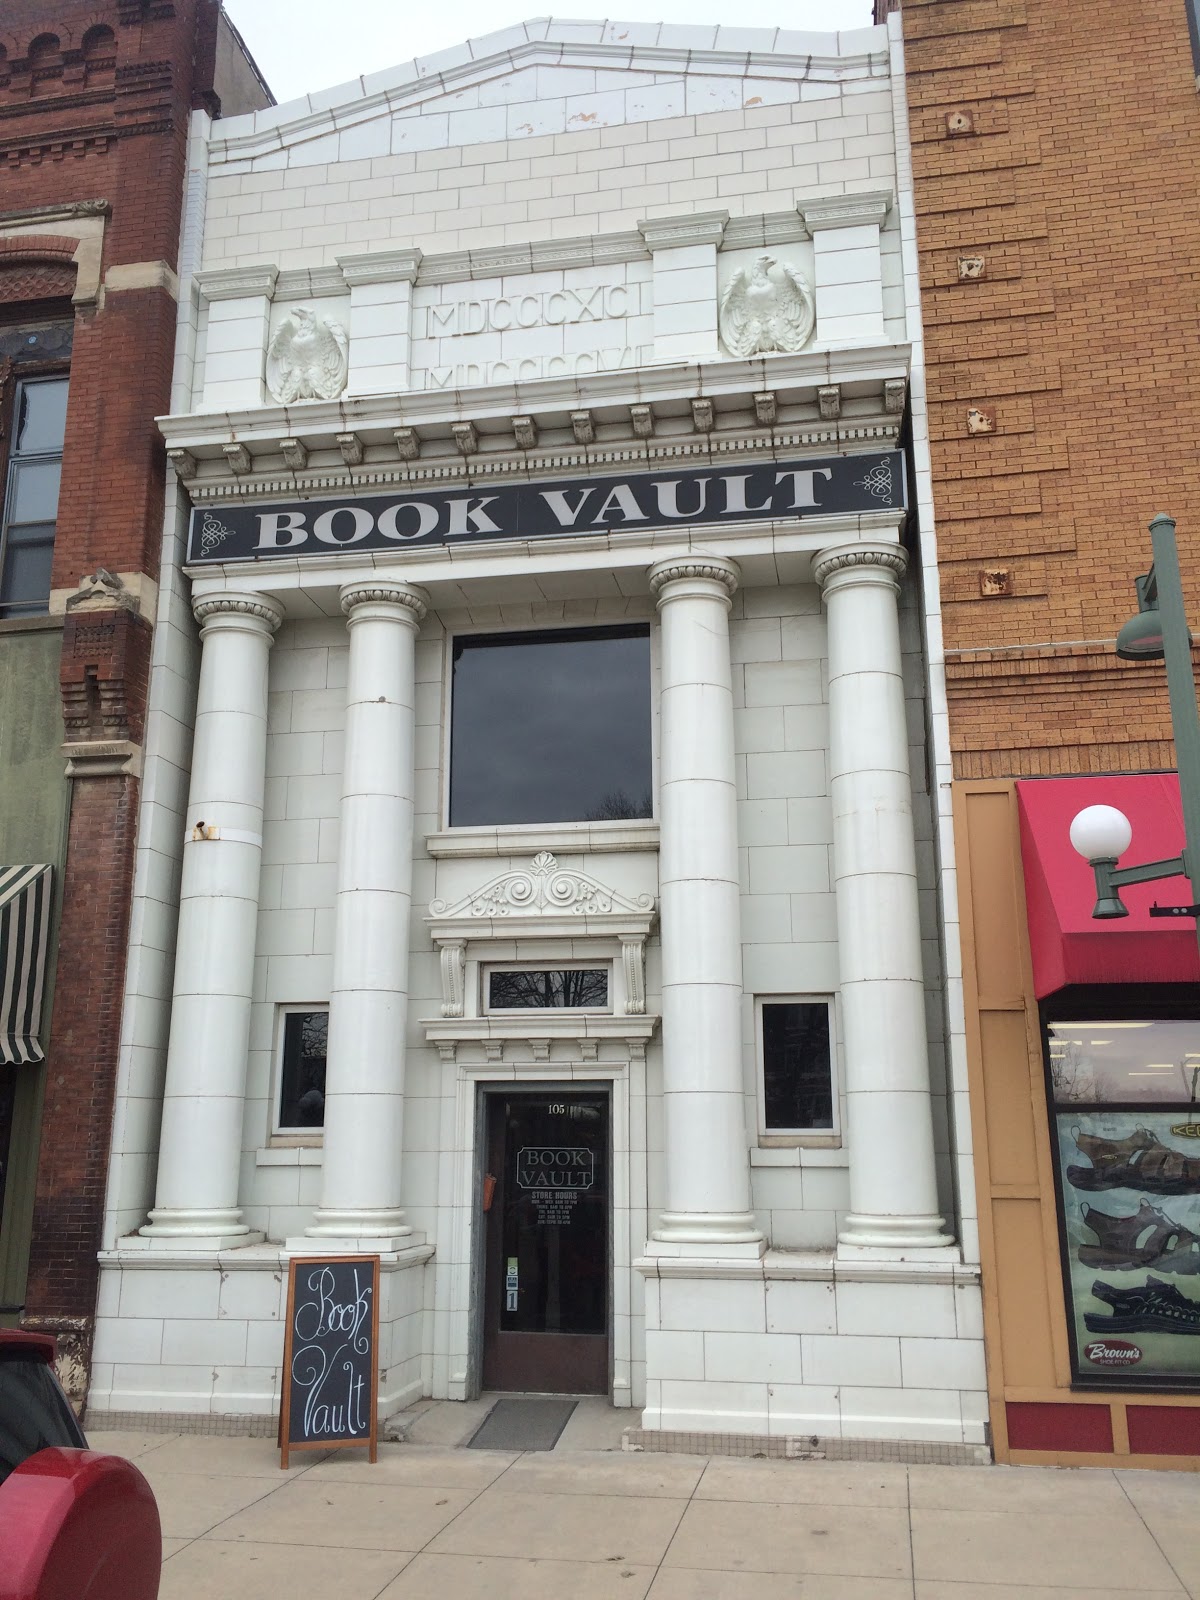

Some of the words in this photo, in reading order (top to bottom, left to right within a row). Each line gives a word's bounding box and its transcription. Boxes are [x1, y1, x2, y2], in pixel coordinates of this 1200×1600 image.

[252, 495, 504, 549] BOOK
[538, 467, 833, 527] VAULT
[548, 1104, 565, 1115] 105
[526, 1150, 587, 1166] BOOK
[521, 1170, 591, 1186] VAULT
[531, 1191, 553, 1199] STORE
[555, 1191, 578, 1200] HOURS
[295, 1266, 373, 1354] Book
[1089, 1343, 1140, 1359] Brown's
[292, 1343, 365, 1437] Vault
